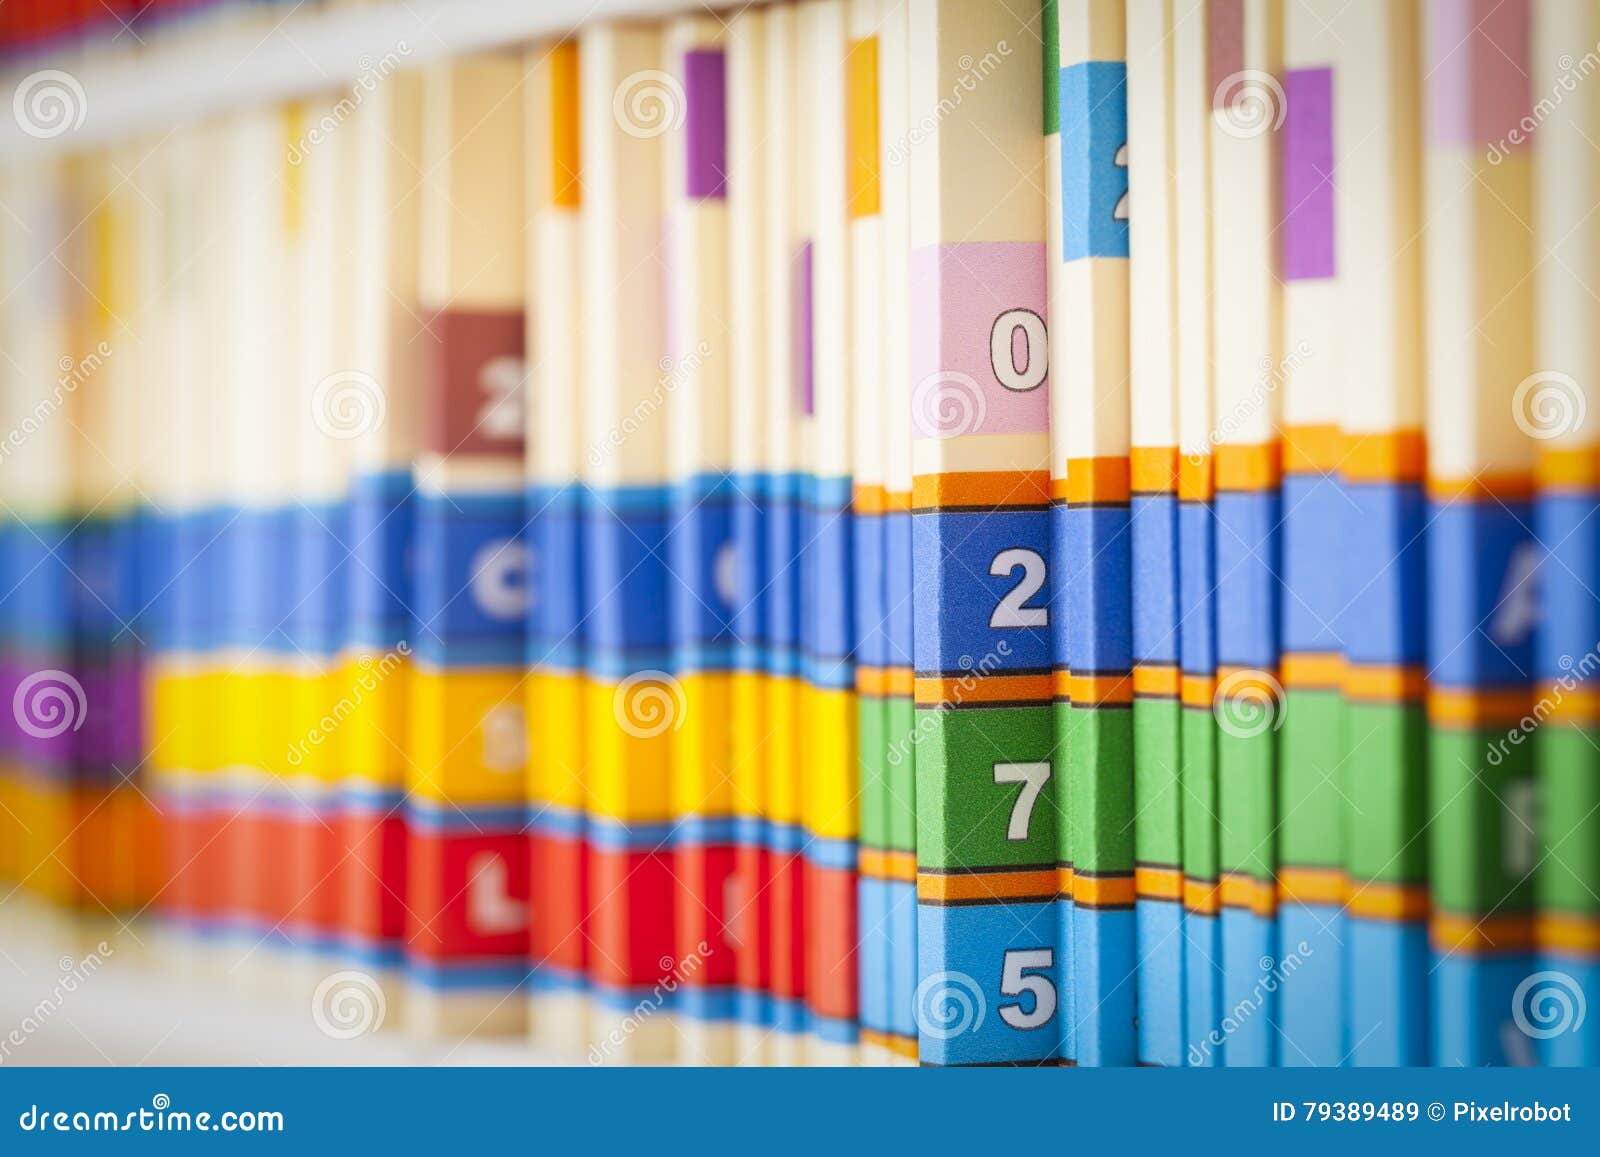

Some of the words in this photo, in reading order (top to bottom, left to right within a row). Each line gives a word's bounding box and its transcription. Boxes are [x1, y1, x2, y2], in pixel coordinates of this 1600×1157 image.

[988, 547, 1048, 628] 2
[993, 761, 1051, 842] 7
[998, 948, 1058, 1031] 5
